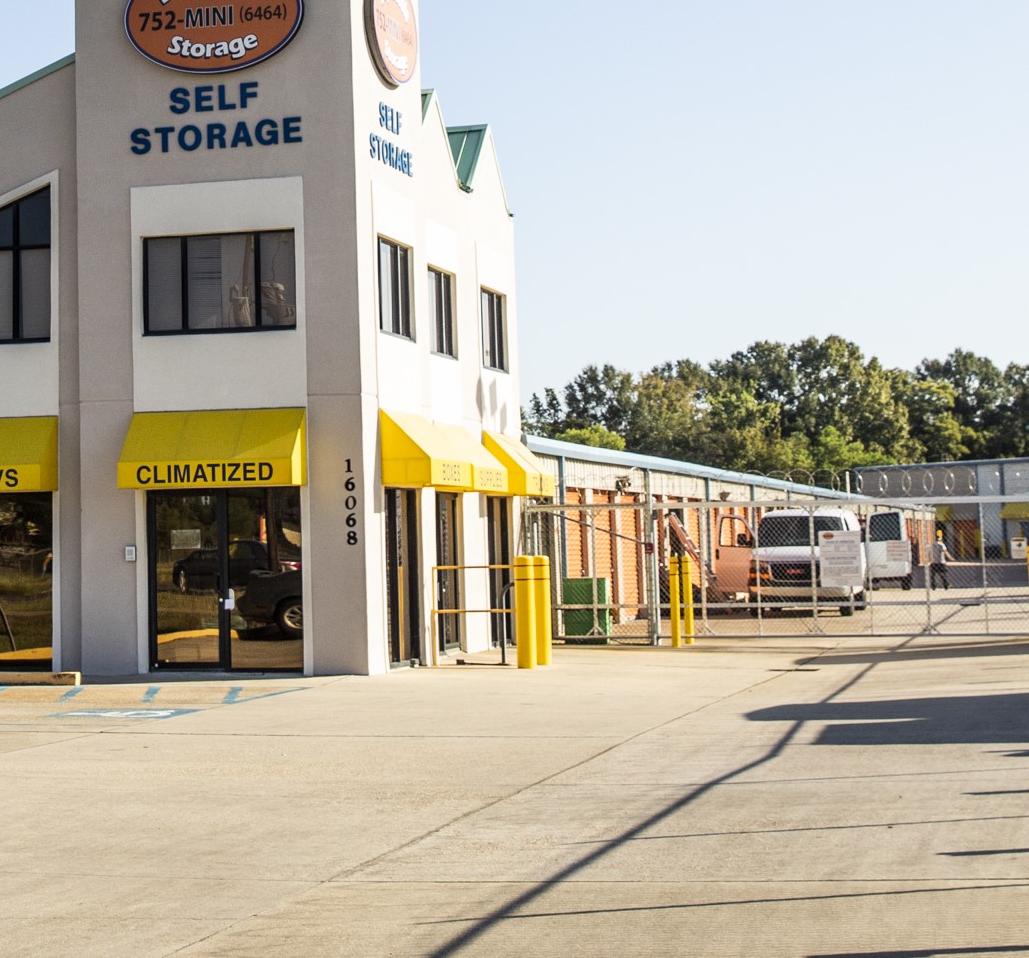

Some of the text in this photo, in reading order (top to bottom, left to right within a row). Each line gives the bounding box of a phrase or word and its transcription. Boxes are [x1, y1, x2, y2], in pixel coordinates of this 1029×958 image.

[139, 2, 287, 32] 752-MINI (6464)
[167, 33, 259, 60] Storage
[169, 81, 259, 114] SELF
[379, 101, 402, 135] SELF
[130, 116, 303, 155] STORAGE
[369, 132, 413, 177] STORAGE
[136, 461, 274, 485] CLIMATIZED
[344, 458, 358, 545] 16068
